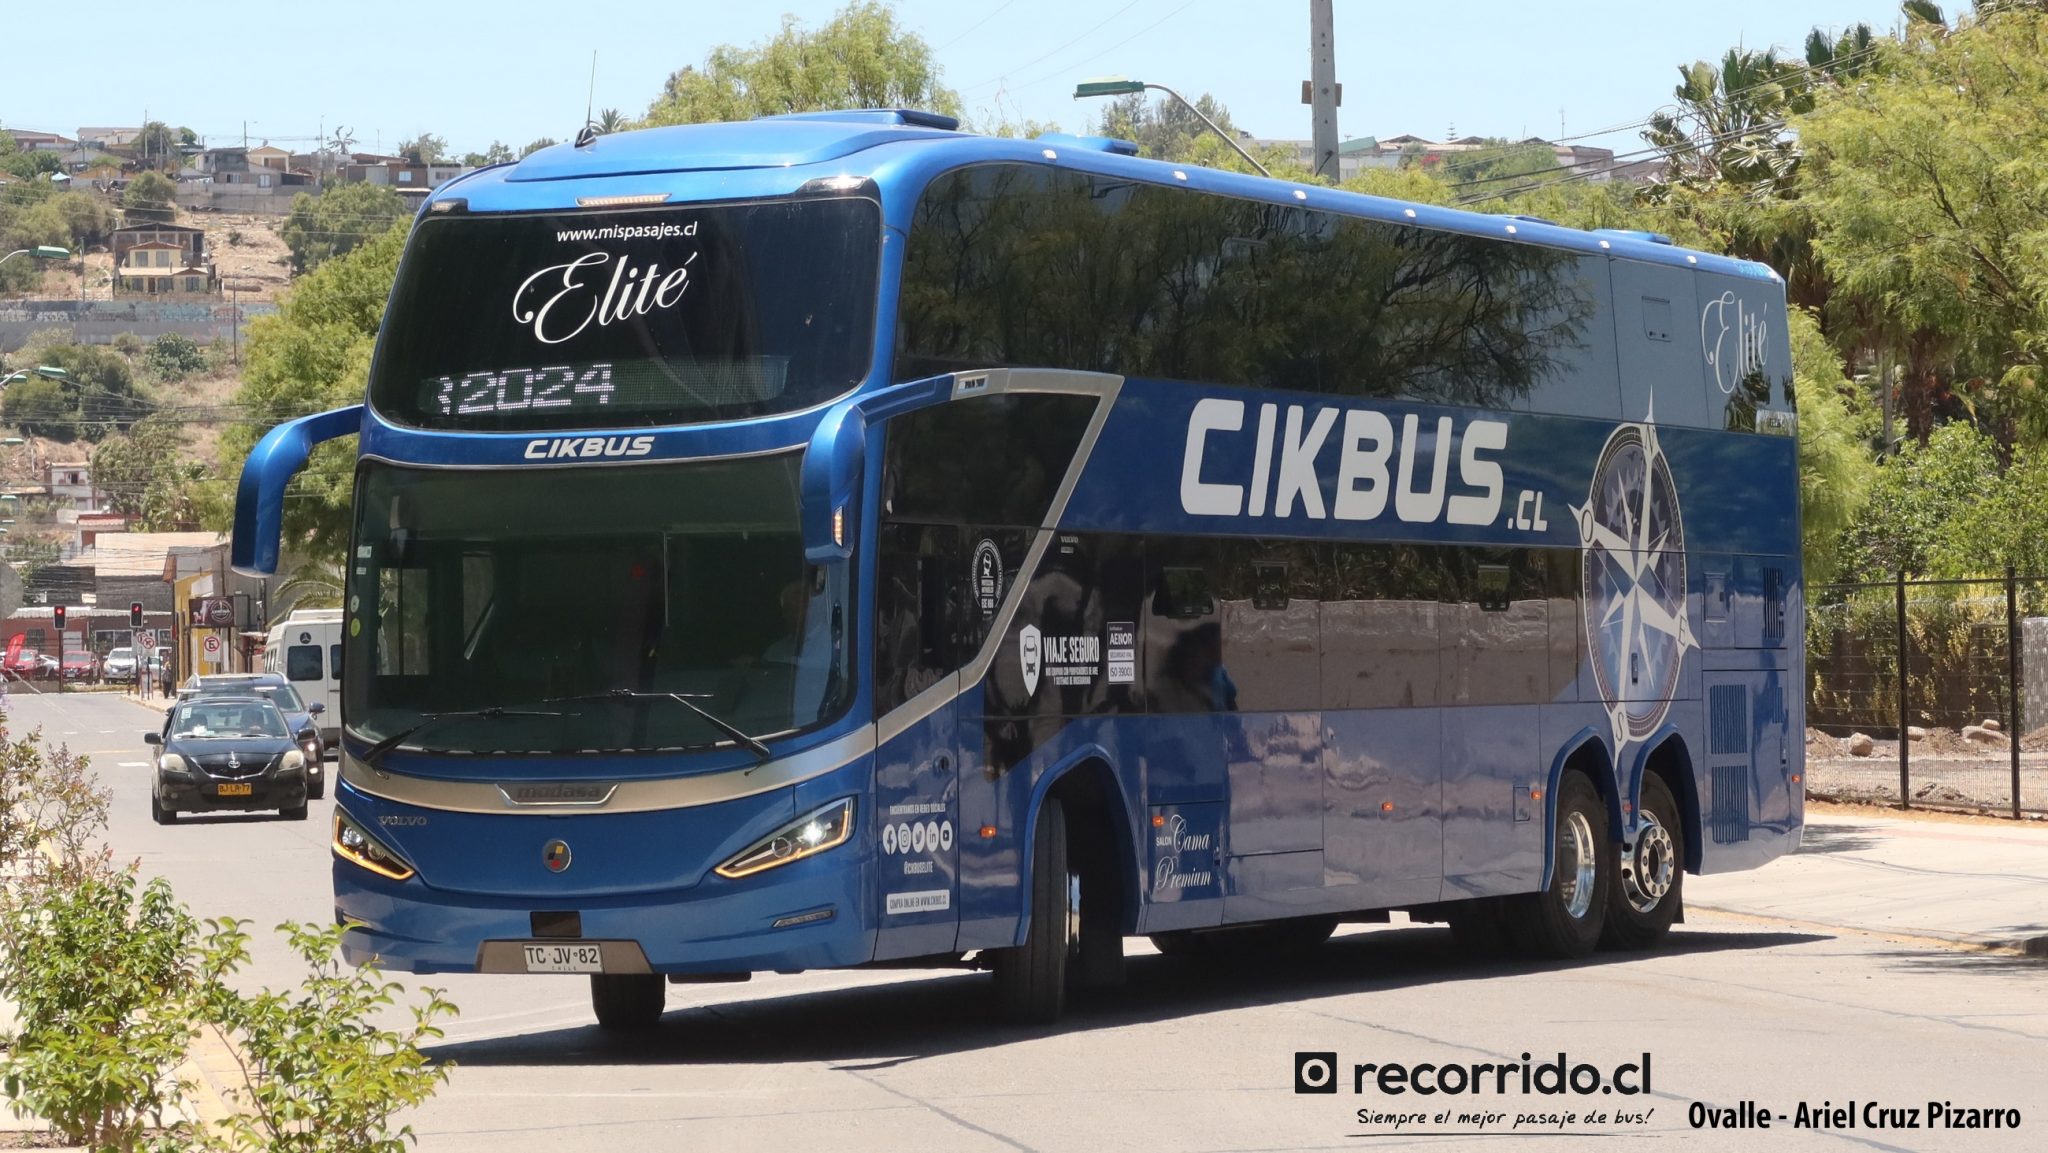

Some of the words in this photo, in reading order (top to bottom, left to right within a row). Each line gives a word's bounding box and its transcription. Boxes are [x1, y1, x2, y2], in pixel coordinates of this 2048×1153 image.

[557, 221, 697, 241] www.mispasajes.cl
[513, 252, 697, 343] Elité
[1702, 291, 1768, 393] Elité
[524, 437, 654, 458] CIKBUS
[1043, 636, 1067, 663] VIAJE
[1069, 636, 1100, 663] SEGURO
[1109, 633, 1133, 646] AENOR
[1110, 667, 1118, 677] ISO
[377, 815, 427, 826] VOLVO
[1156, 836, 1173, 847] SALON
[1170, 814, 1210, 853] Cama
[1155, 855, 1211, 890] Premium
